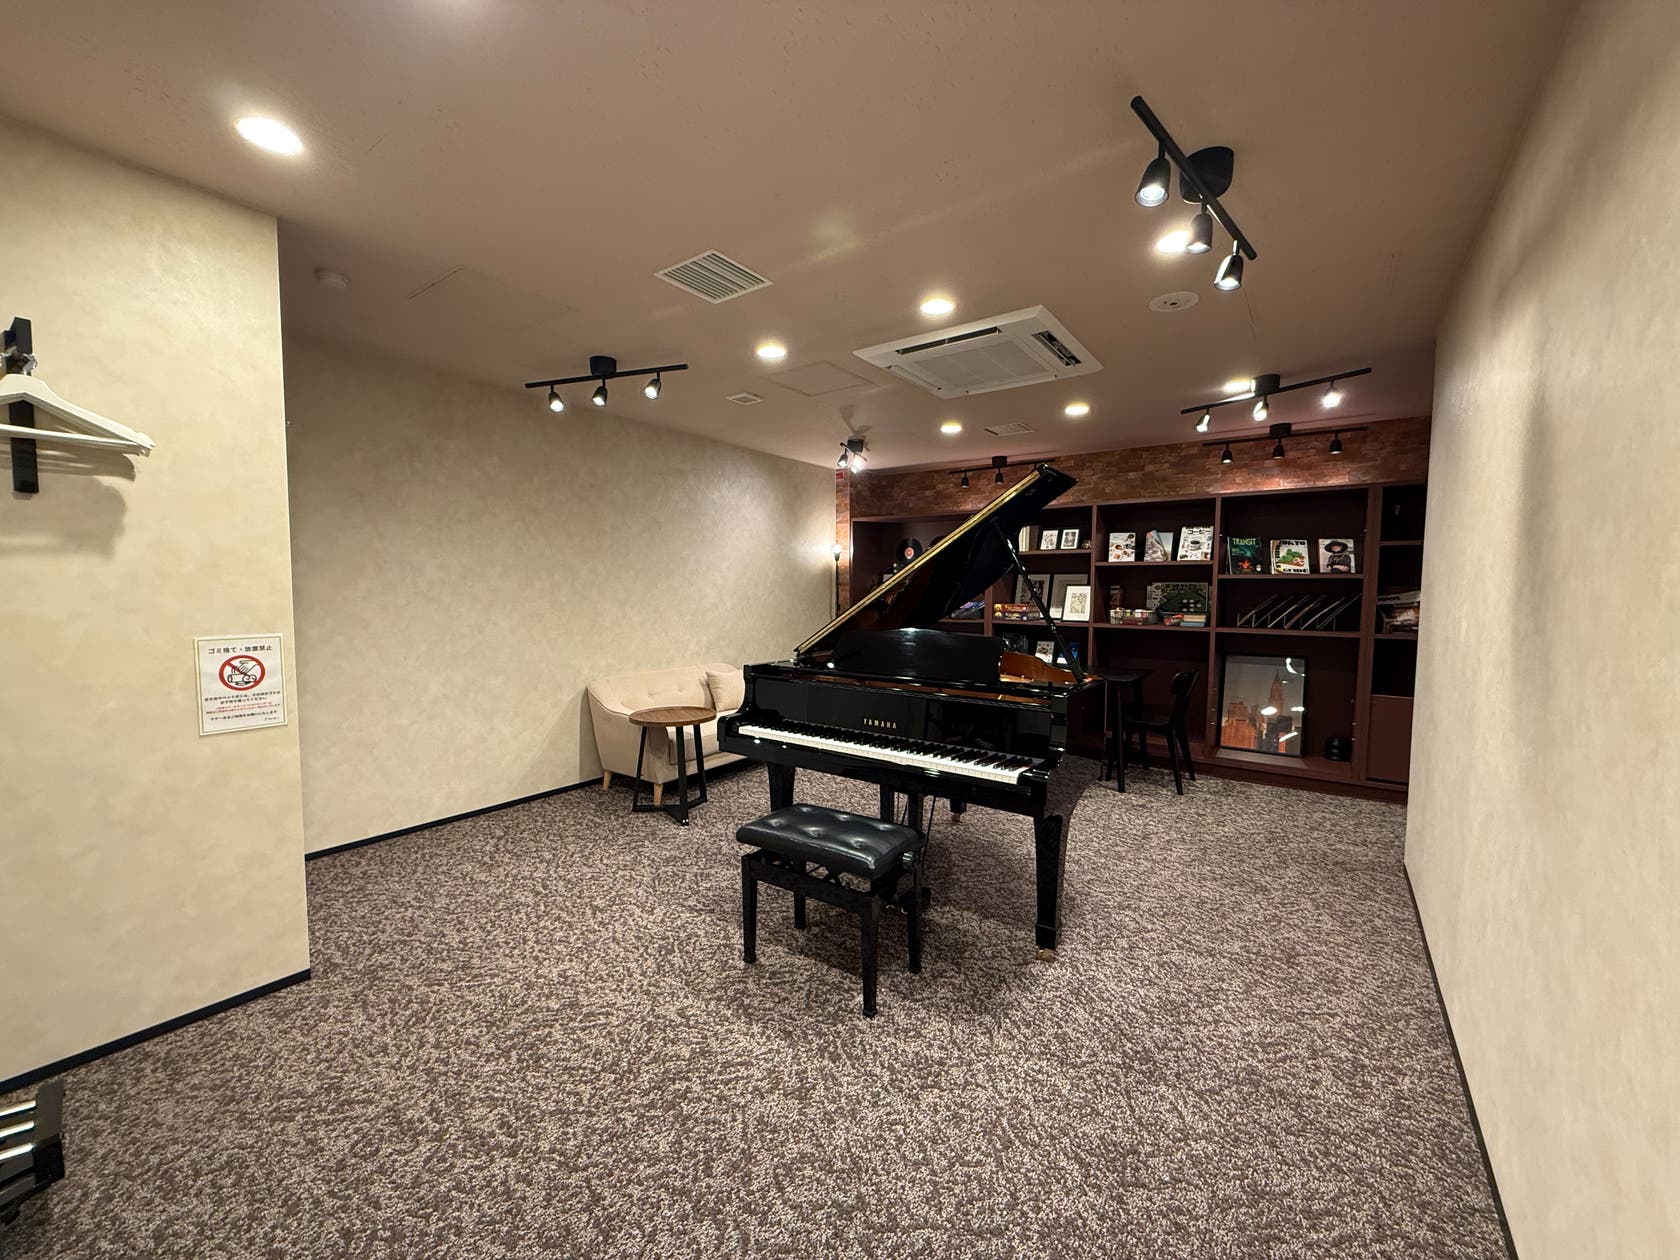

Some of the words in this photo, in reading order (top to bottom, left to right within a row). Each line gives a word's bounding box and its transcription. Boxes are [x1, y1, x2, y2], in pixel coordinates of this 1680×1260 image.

[1232, 537, 1257, 546] TRANSIT
[208, 645, 272, 654] ゴミ捨て・放置禁止
[863, 718, 897, 729] YAMAHA
